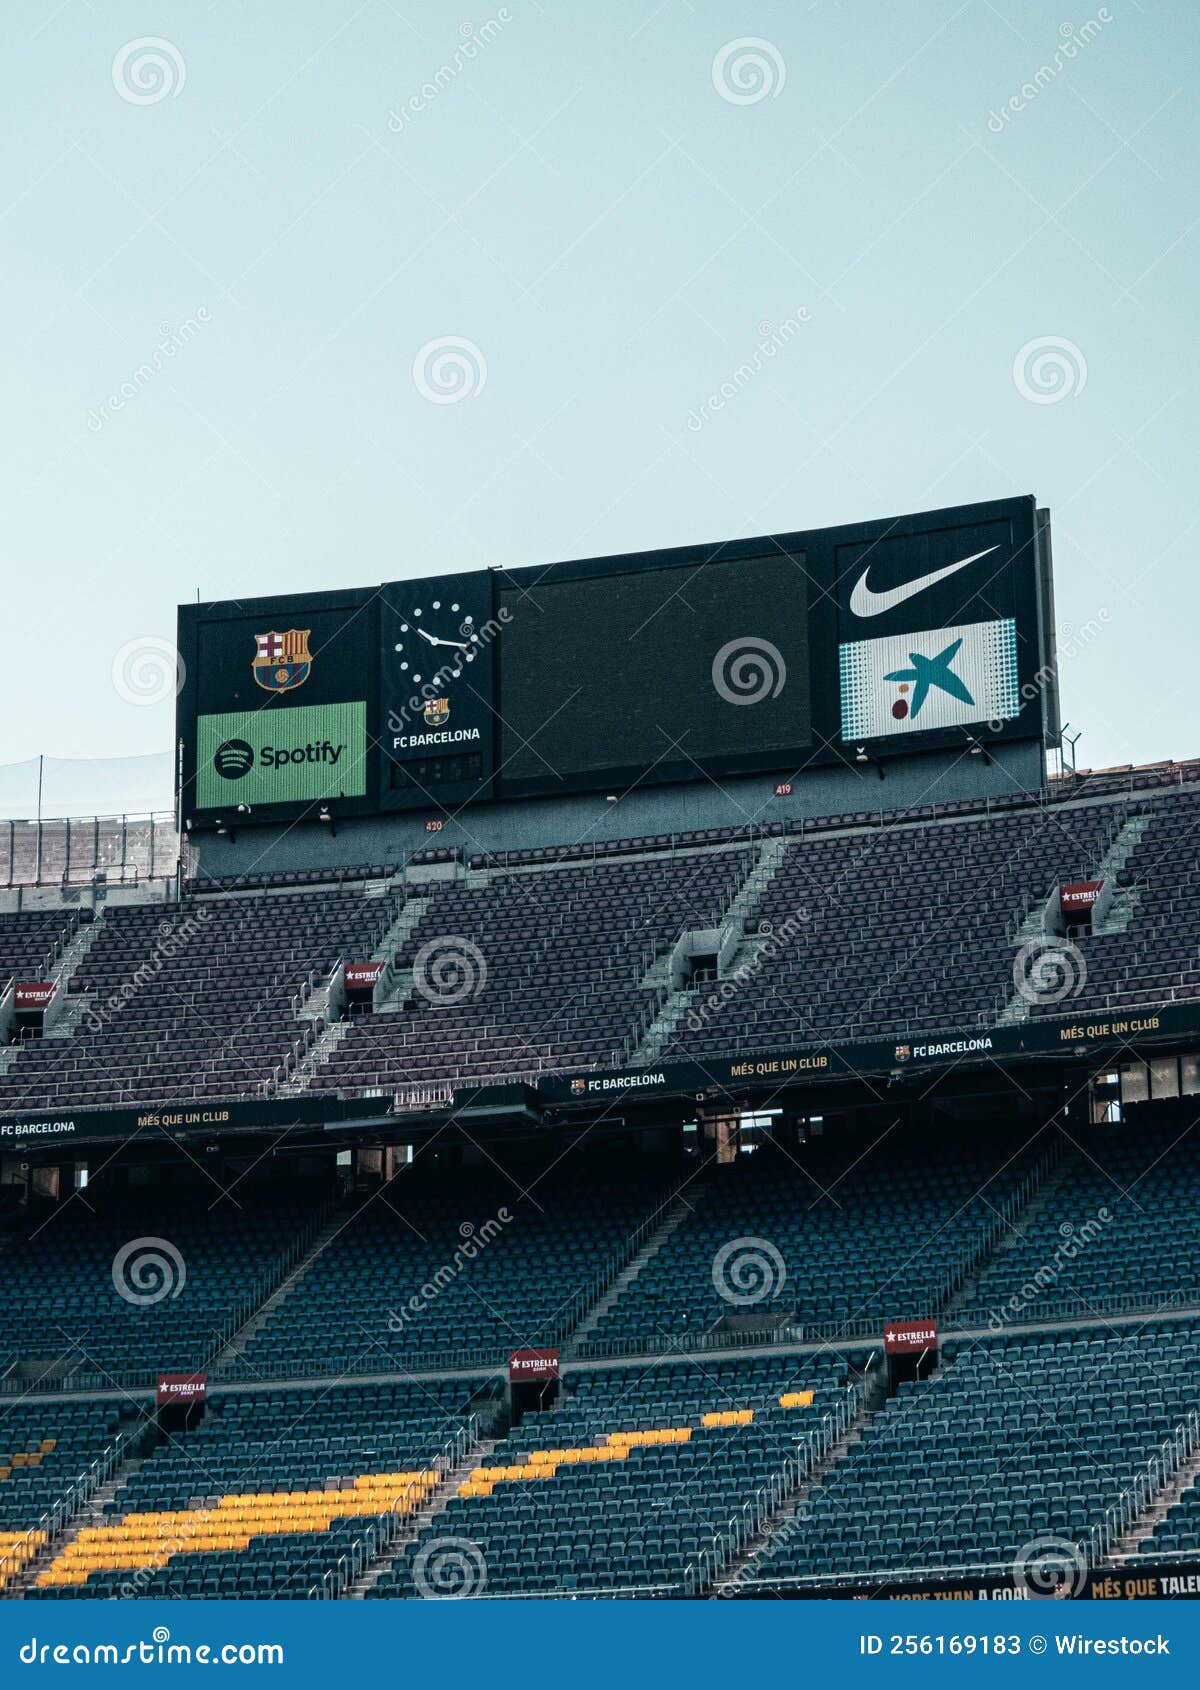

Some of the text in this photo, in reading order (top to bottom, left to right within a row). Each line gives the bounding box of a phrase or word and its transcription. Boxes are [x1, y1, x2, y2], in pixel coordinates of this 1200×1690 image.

[393, 728, 480, 749] FC BARCELONA
[260, 741, 342, 769] Spotify
[427, 821, 442, 832] 420
[1060, 1017, 1160, 1040] MÉS QUE UN CLUB
[913, 1038, 993, 1058] FC BARCELONA
[731, 1056, 828, 1077] MÉS QUE UN CLUB
[588, 1073, 665, 1091] FC BARCELONA
[162, 1114, 183, 1126] QUE
[185, 1113, 200, 1123] UN
[202, 1111, 229, 1122] CLUB
[1, 1121, 75, 1136] FC BARCELONA
[897, 1330, 936, 1342] ESTRELLA
[521, 1359, 558, 1368] ESTRELLA
[170, 1384, 205, 1392] ESTRELLA
[1091, 1576, 1121, 1600] MÉS
[1125, 1578, 1157, 1600] QUE
